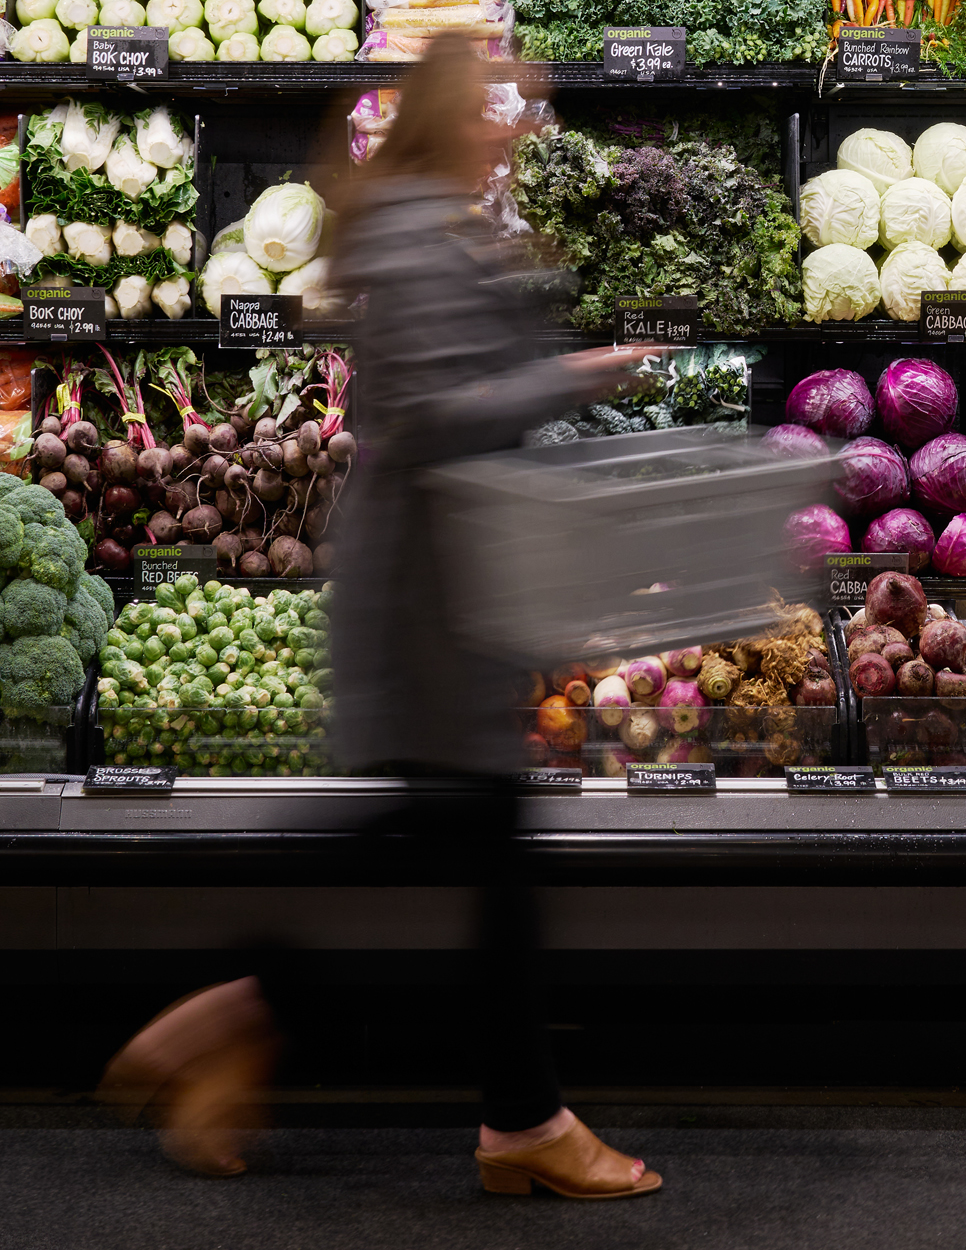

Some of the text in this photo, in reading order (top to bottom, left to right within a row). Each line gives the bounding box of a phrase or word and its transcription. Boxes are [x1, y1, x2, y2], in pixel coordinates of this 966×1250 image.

[90, 27, 134, 39] organic
[607, 28, 651, 40] organic
[842, 29, 885, 39] organic
[93, 41, 115, 52] Baby
[611, 42, 674, 57] Green Kale
[844, 41, 909, 55] Bunched Rainbow
[93, 51, 149, 65] BOK CHOY
[843, 52, 892, 67] CARROTS
[630, 58, 660, 71] $3.99
[890, 61, 908, 74] $3.99
[133, 66, 156, 77] $3.99
[27, 288, 71, 299] organic
[231, 299, 260, 314] Nappa
[619, 298, 662, 309] organic
[29, 306, 85, 320] BOK CHOY
[624, 311, 644, 319] Red
[926, 305, 950, 315] Green
[230, 311, 279, 329] CABBAGE
[69, 321, 93, 333] $2.99
[624, 321, 690, 337] KALE $3.99
[262, 330, 284, 343] $2.49
[138, 546, 181, 558] organic
[142, 560, 178, 570] Bunched
[827, 555, 871, 567] organic
[142, 571, 163, 583] RED
[831, 569, 850, 580] Red
[94, 774, 150, 782] SPROUTS
[634, 771, 692, 780] TURNIPS
[794, 773, 857, 783] Celery Root
[894, 776, 938, 784] BEETS
